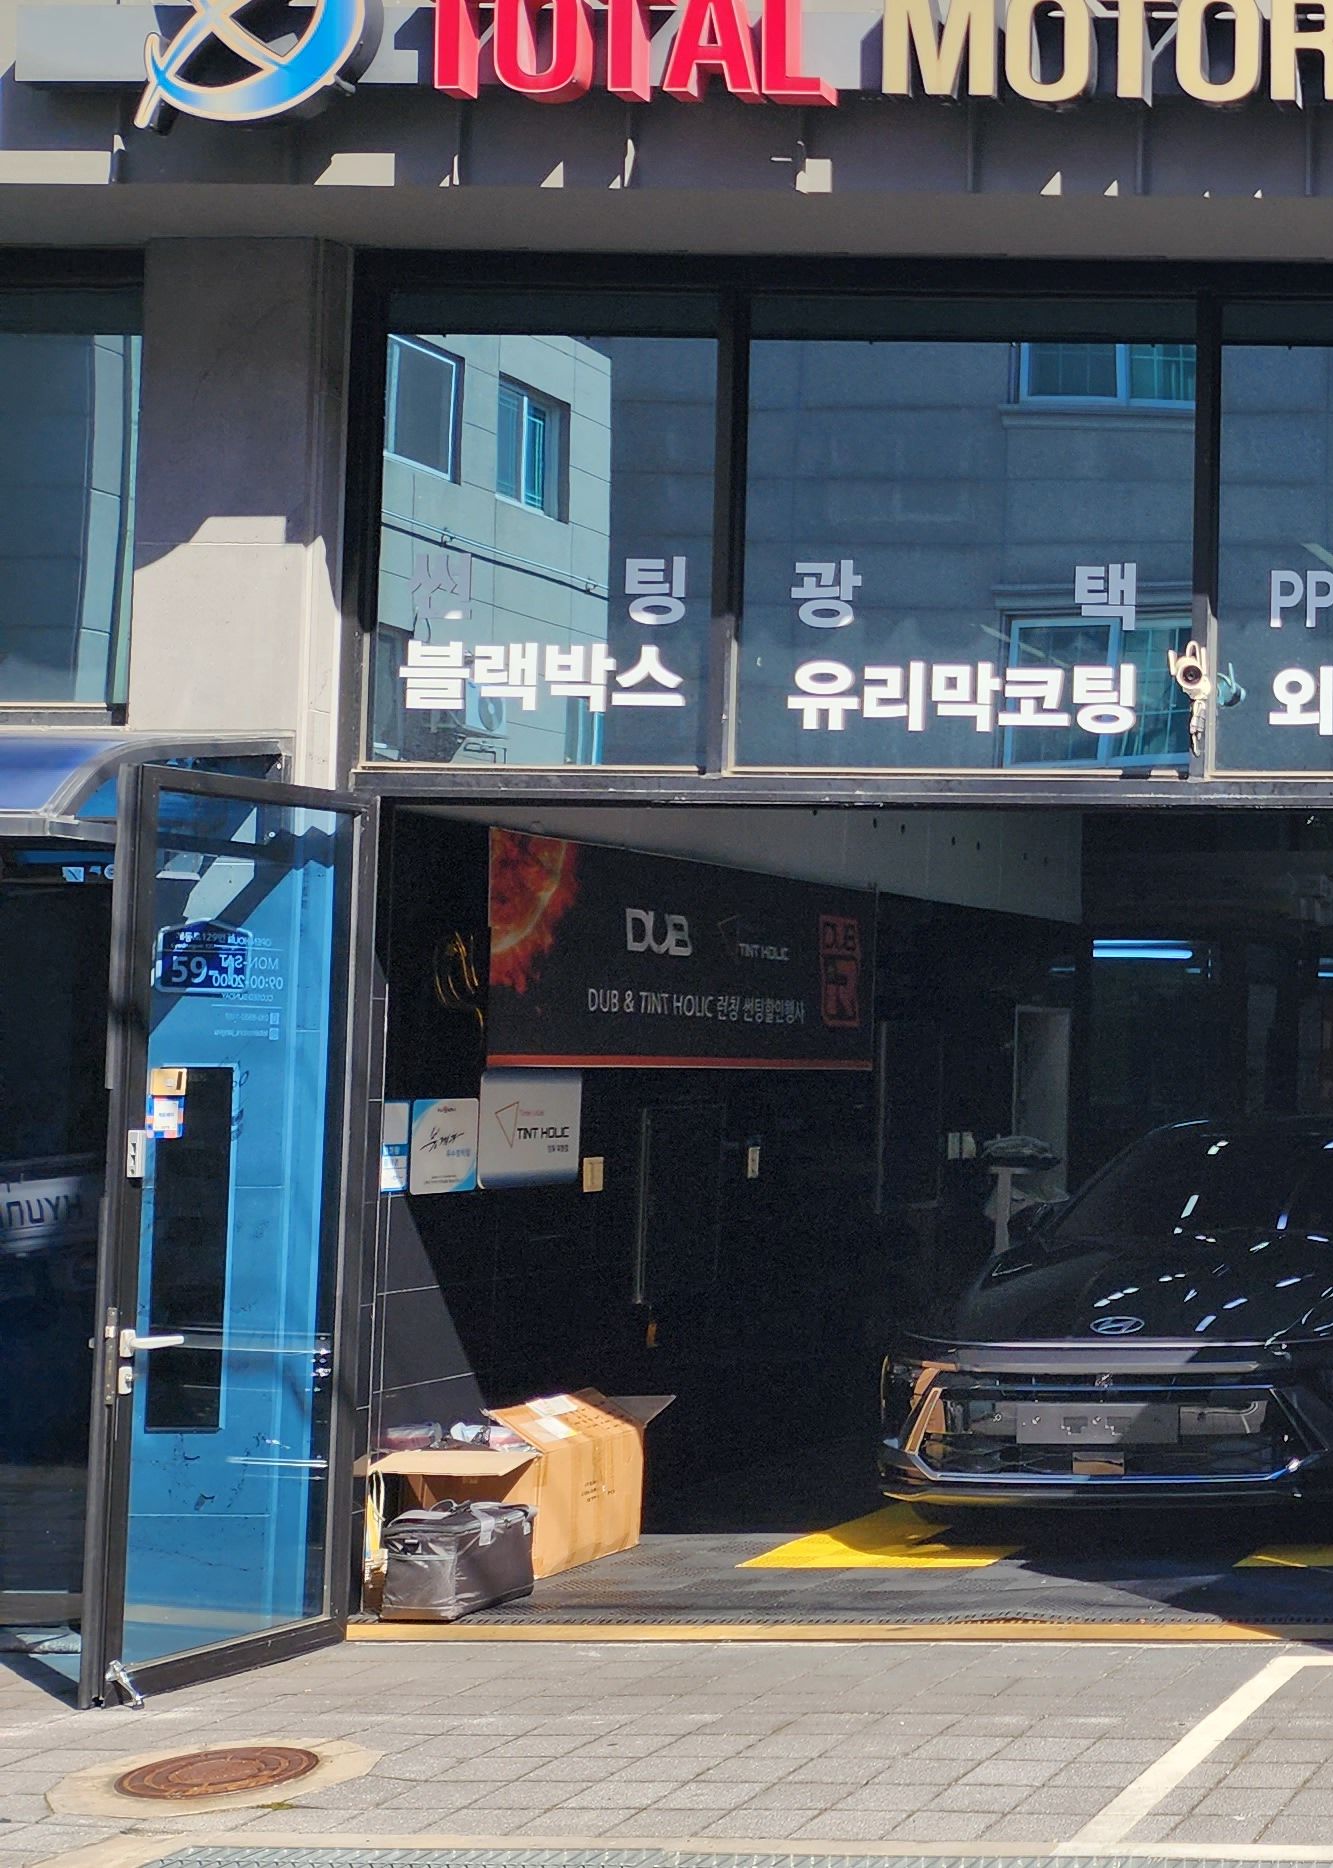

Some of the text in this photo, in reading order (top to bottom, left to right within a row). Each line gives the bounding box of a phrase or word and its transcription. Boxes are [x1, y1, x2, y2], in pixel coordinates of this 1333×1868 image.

[432, 0, 835, 103] TOTAL
[398, 640, 686, 712] 블랙박스
[786, 658, 1137, 734] 유리막코팅
[625, 908, 693, 957] DUB
[588, 987, 620, 1013] DUB
[623, 989, 635, 1013] &
[638, 990, 669, 1016] TINT
[673, 992, 713, 1019] HOLIC
